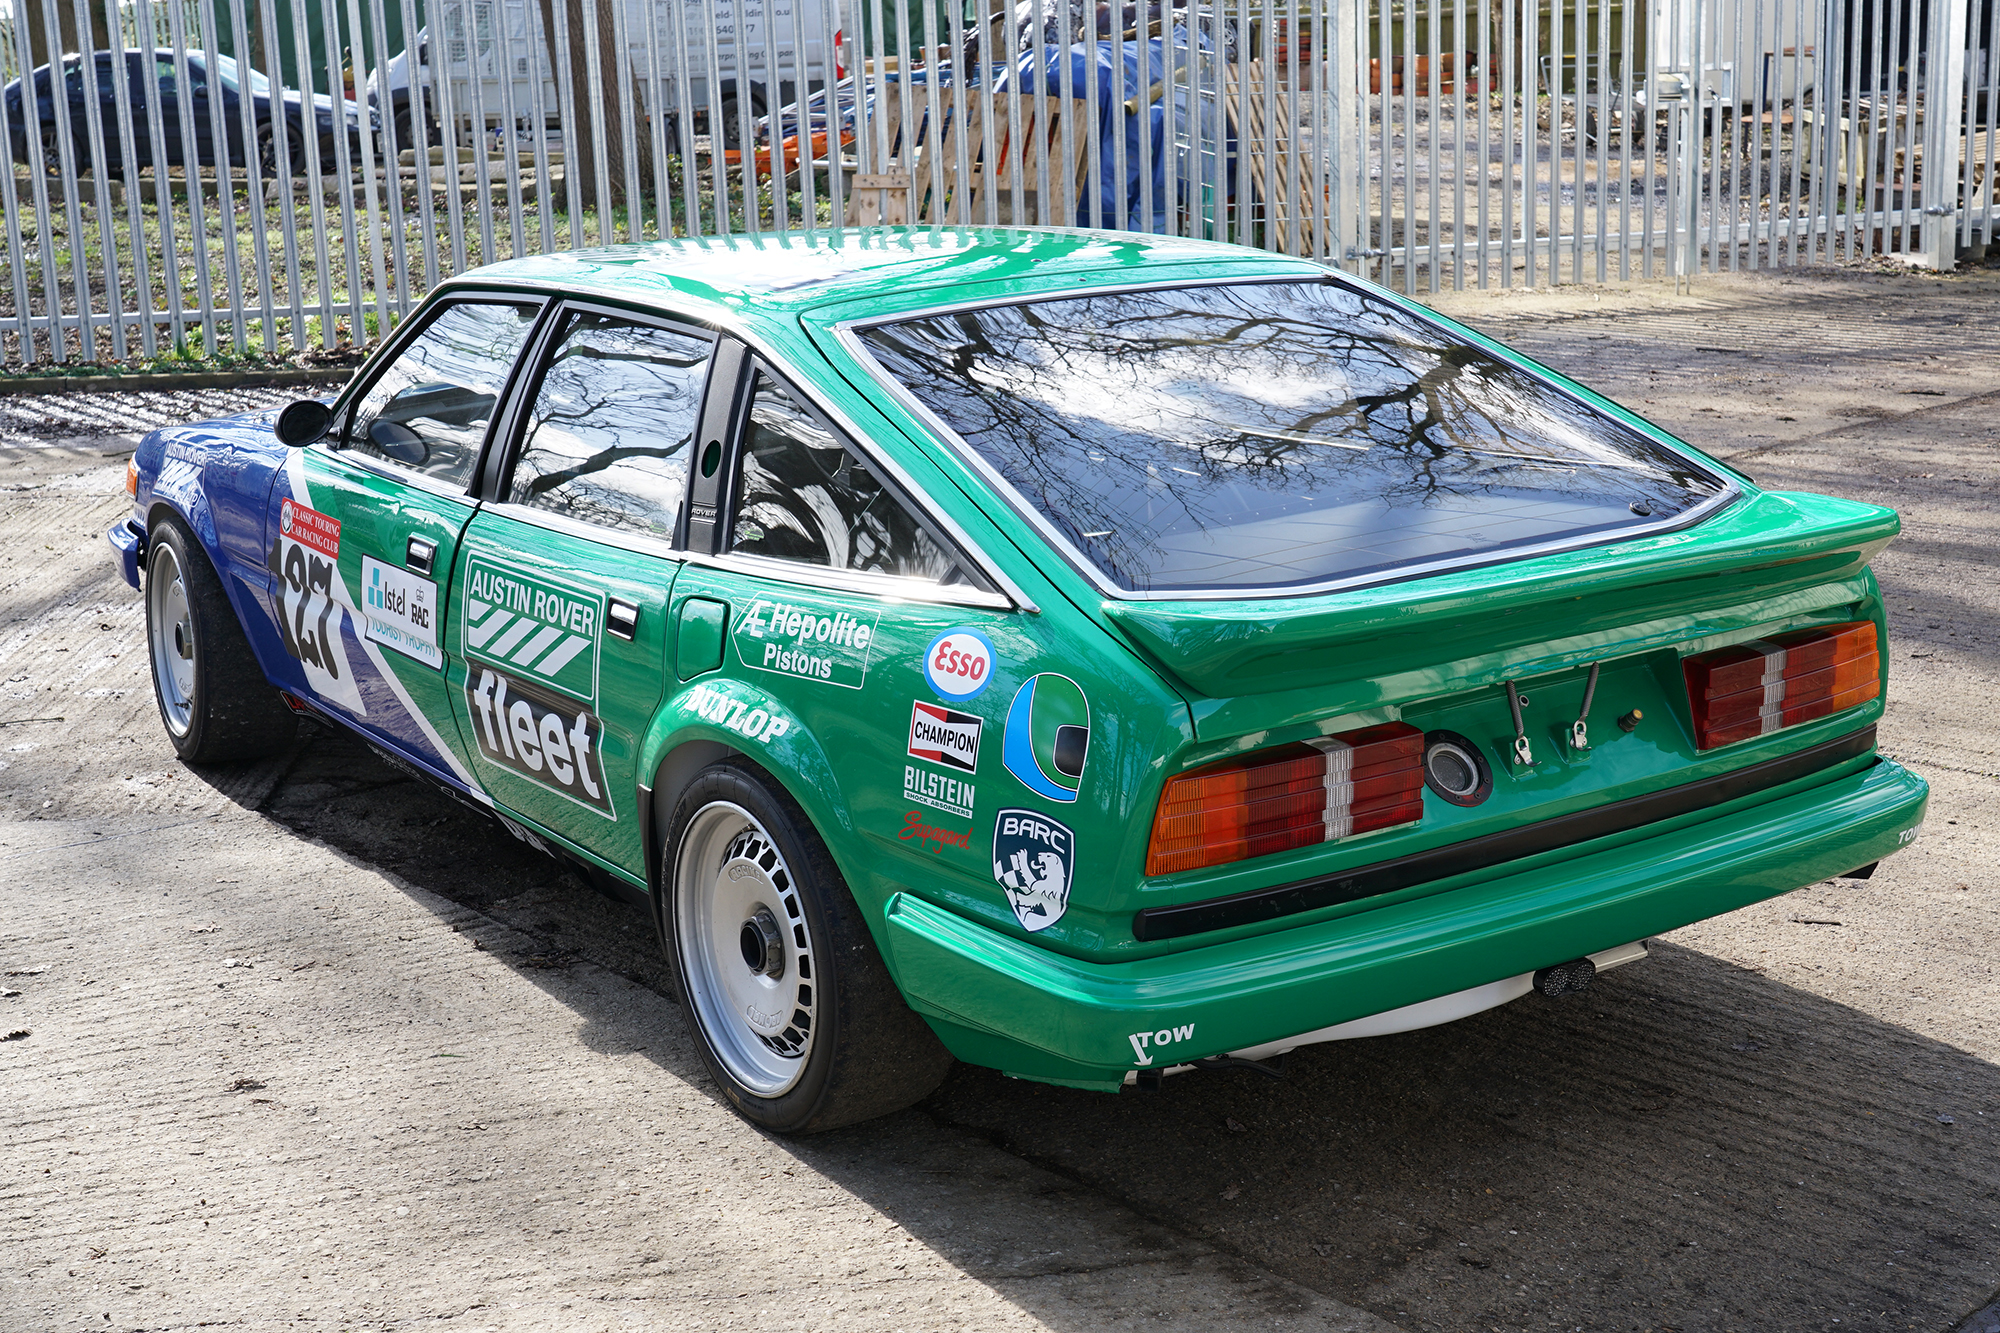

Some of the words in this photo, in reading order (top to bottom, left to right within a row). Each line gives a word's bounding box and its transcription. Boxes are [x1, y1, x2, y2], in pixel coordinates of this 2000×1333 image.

[292, 507, 314, 526] CLASSIC
[314, 517, 339, 537] TOURING
[691, 508, 717, 517] ROVER
[291, 523, 303, 537] CAR
[303, 528, 323, 547] RACING
[323, 538, 339, 554] CLUB
[384, 581, 406, 616] Istel
[411, 603, 429, 629] RAC
[470, 570, 531, 614] AUSTIN
[534, 590, 595, 637] ROVER
[369, 615, 402, 642] TOURIST
[401, 630, 435, 658] TROPHY
[769, 602, 870, 649] Hepolite
[763, 642, 832, 679] Pistons
[474, 668, 600, 799] fleet
[684, 684, 790, 744] DUNLOP
[914, 720, 976, 754] CHAMPION
[904, 765, 976, 809] BILSTEIN
[906, 791, 928, 804] SHOCK
[930, 799, 970, 817] ABSORBERS
[898, 811, 974, 854] Supagard
[1003, 817, 1066, 855] BARC
[1137, 1023, 1195, 1048] TOW
